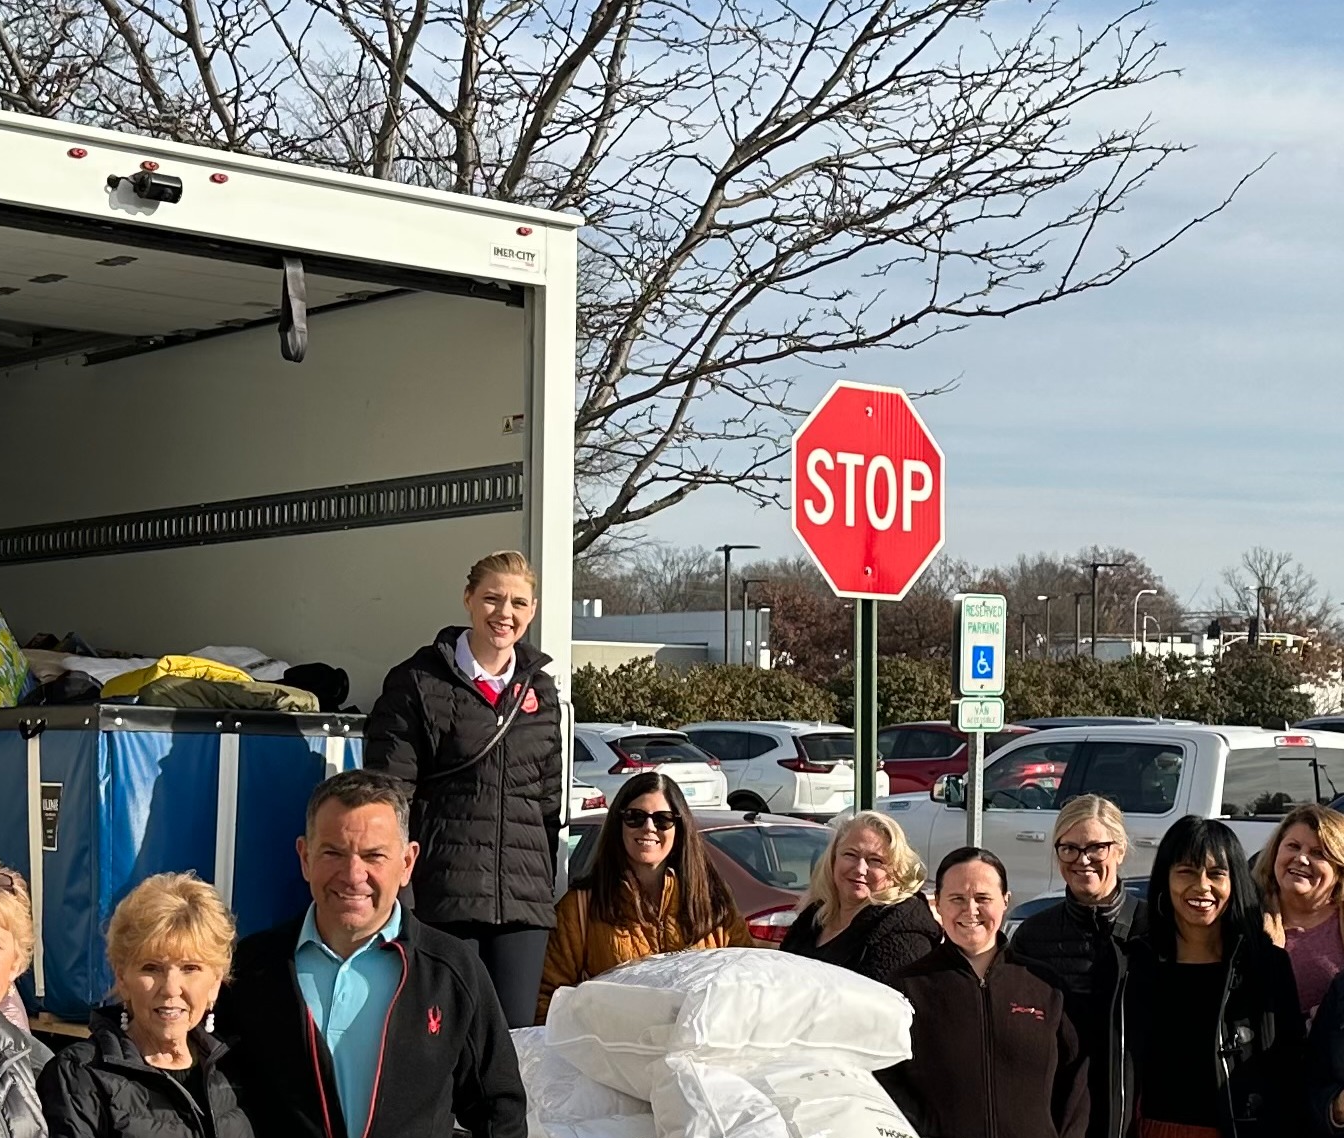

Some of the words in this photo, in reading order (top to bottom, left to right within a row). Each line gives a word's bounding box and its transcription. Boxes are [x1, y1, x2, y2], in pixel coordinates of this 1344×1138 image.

[803, 447, 933, 532] STOP
[965, 604, 1002, 618] RESERVED
[967, 621, 999, 635] PARKING
